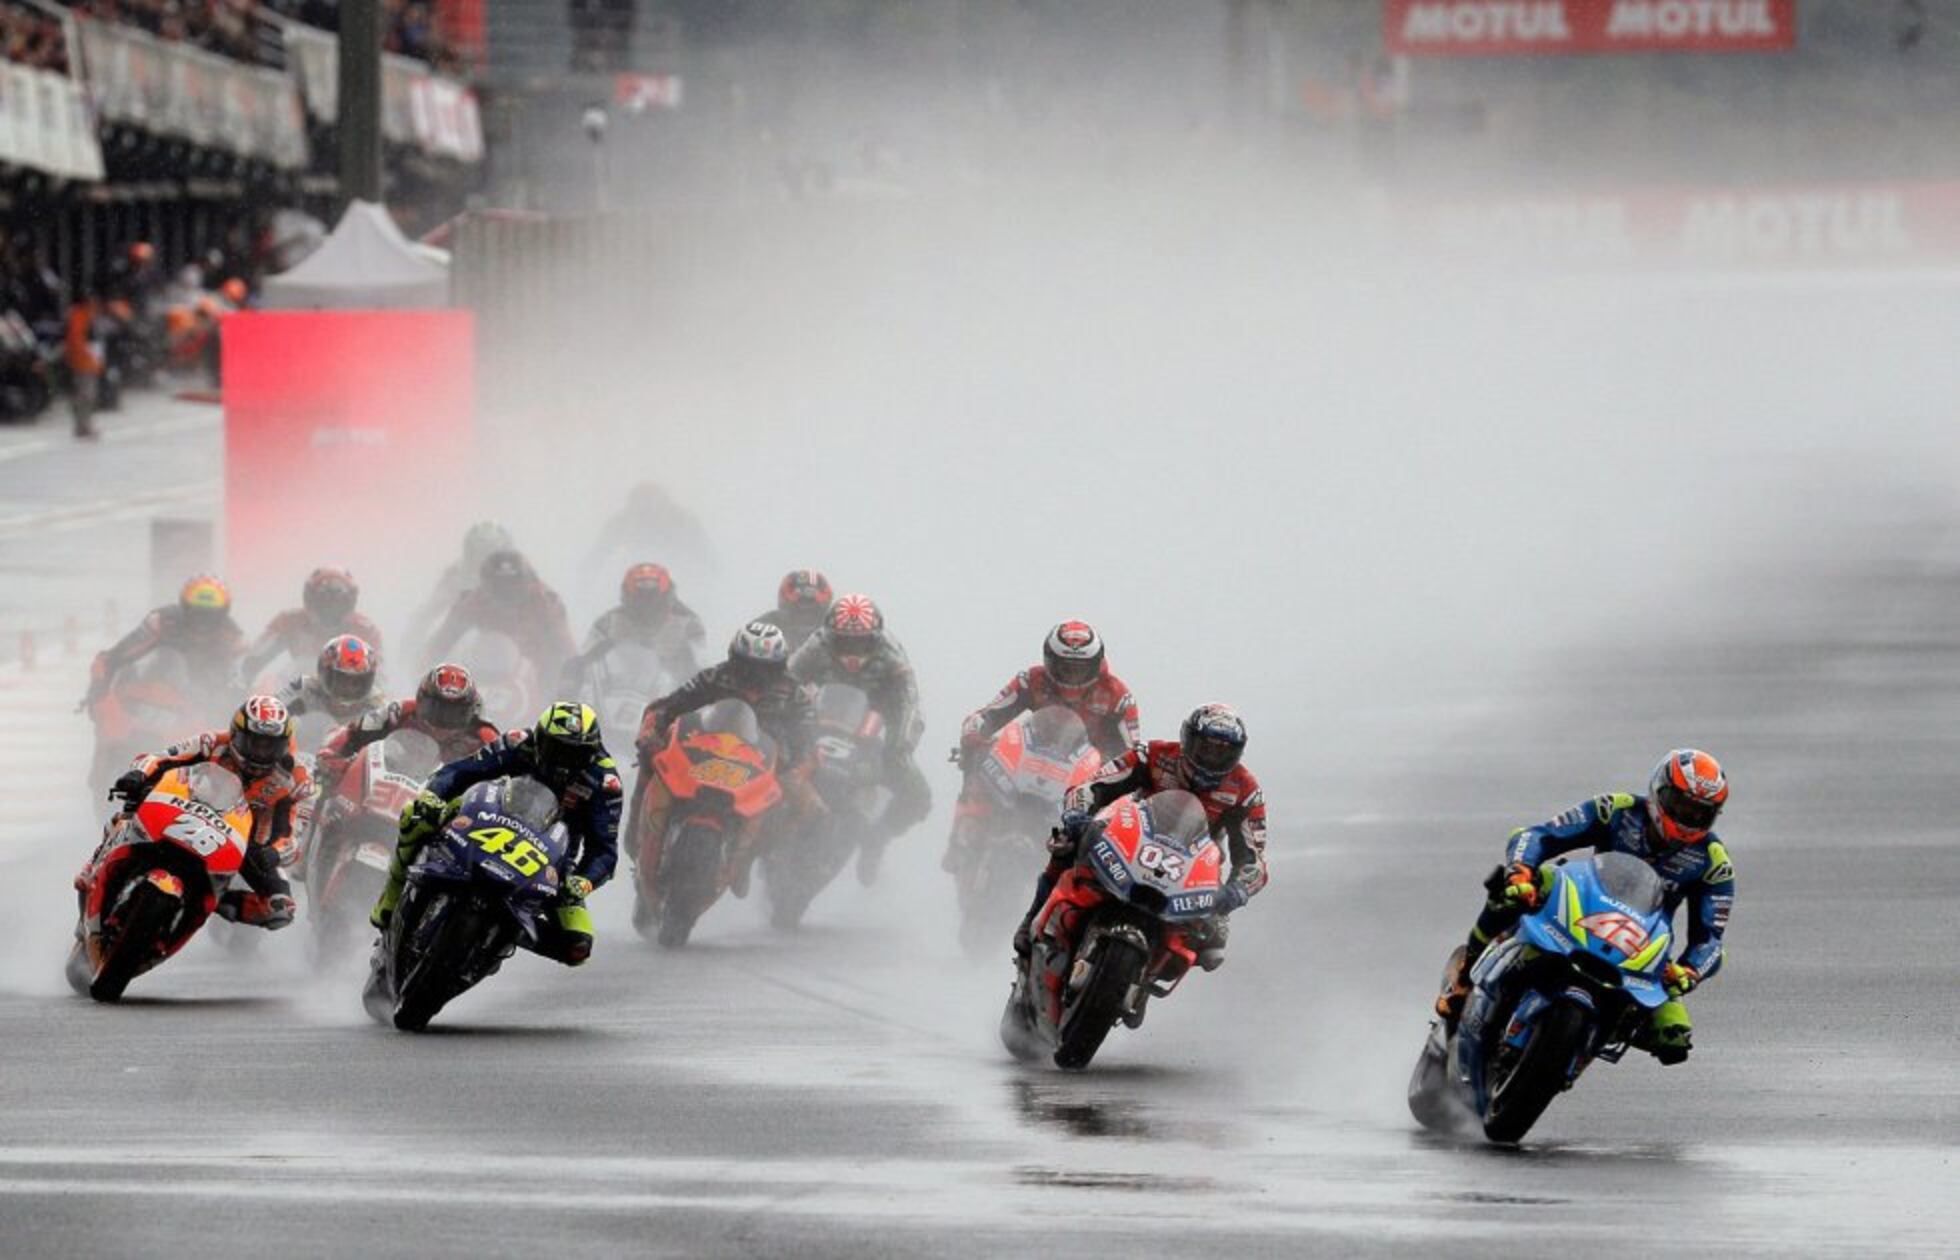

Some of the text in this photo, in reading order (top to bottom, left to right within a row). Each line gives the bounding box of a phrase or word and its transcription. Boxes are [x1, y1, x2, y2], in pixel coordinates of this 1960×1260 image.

[1404, 0, 1777, 39] MOTUL MOTUL
[163, 812, 227, 856] 26
[468, 827, 549, 877] 46
[1139, 844, 1185, 881] 04
[1574, 911, 1650, 960] 42
